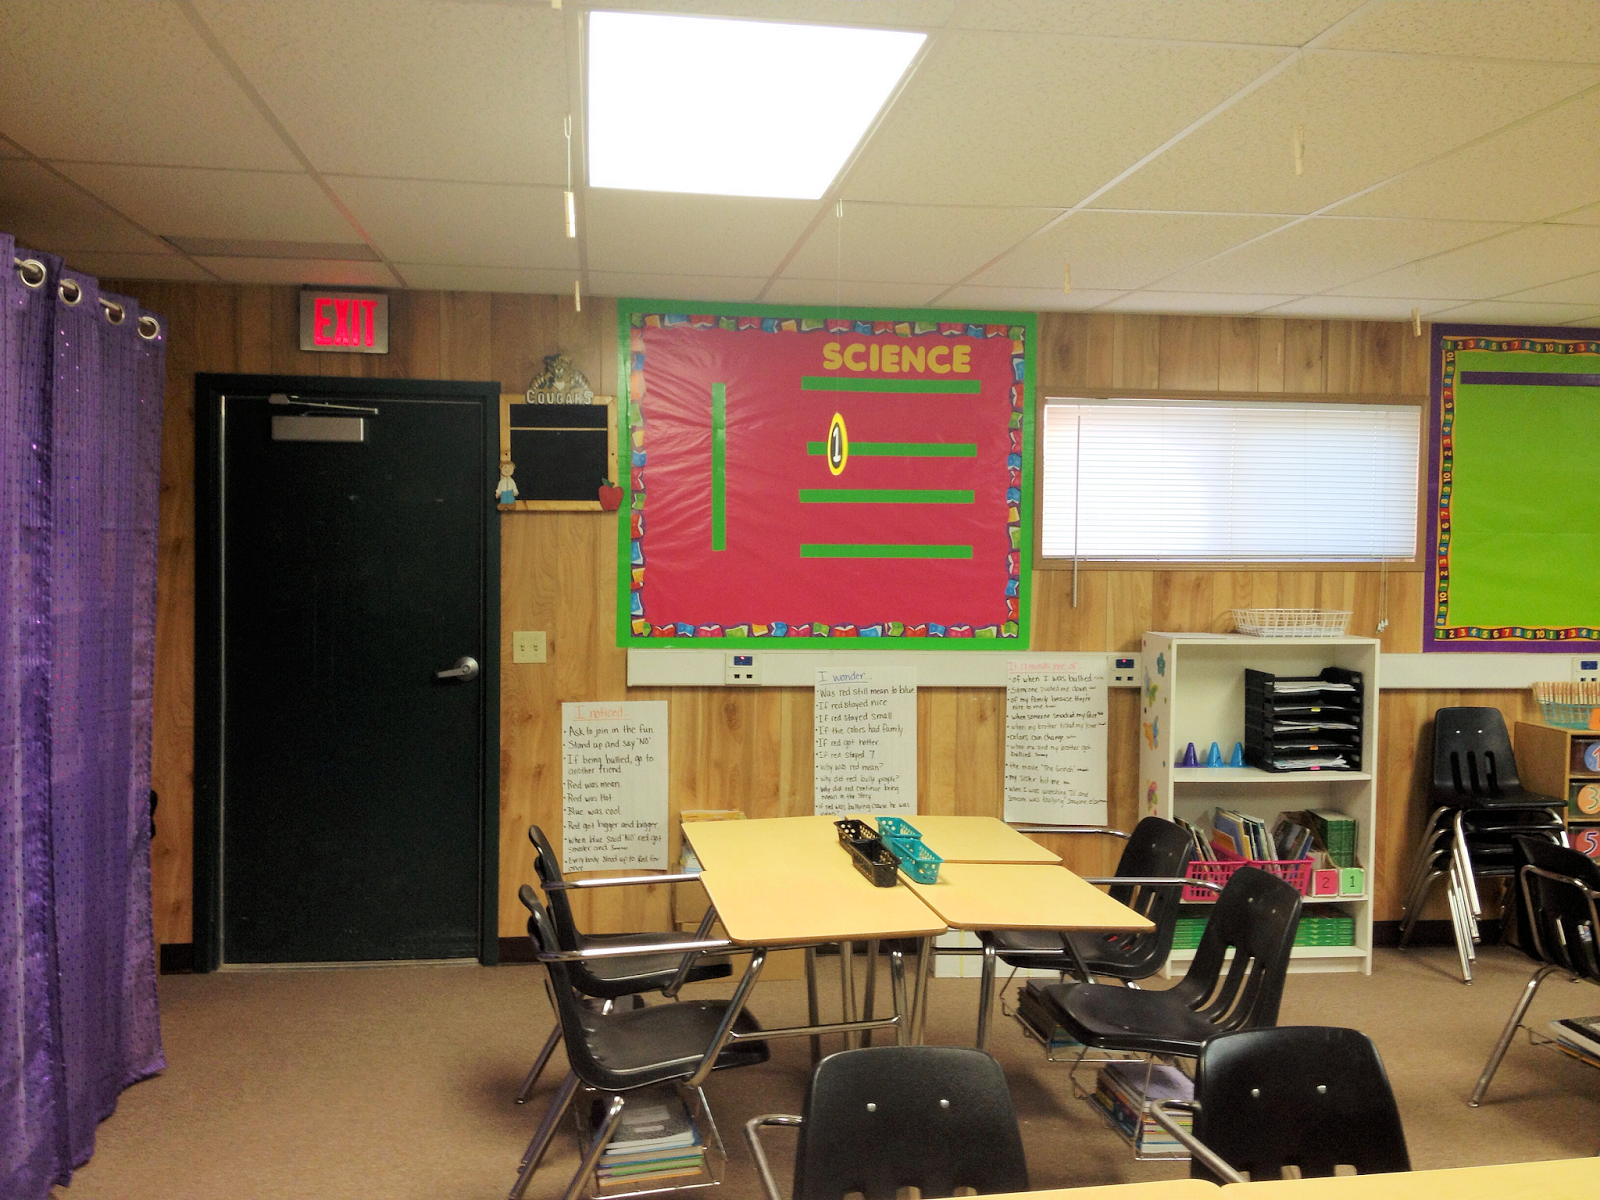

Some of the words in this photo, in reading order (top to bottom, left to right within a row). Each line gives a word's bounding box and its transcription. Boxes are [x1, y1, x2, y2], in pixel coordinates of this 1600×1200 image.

[314, 297, 378, 347] EXIT
[822, 341, 972, 374] SCIENCE
[527, 390, 593, 404] COUGARS
[832, 426, 842, 463] 1
[1449, 630, 1454, 638] 2
[1493, 630, 1499, 638] 6
[1536, 630, 1545, 638] 10
[1571, 629, 1576, 637] 3
[818, 671, 827, 681] I
[1068, 673, 1091, 682] bullied
[820, 688, 835, 697] Was
[839, 687, 850, 696] red
[899, 685, 915, 693] blue
[819, 702, 828, 710] If
[575, 706, 585, 719] I
[871, 712, 892, 720] small
[569, 726, 585, 736] Ask
[594, 728, 608, 737] join
[623, 725, 636, 733] the
[639, 724, 654, 733] fun
[818, 726, 828, 734] If
[847, 726, 865, 734] colors
[868, 724, 880, 732] had
[883, 723, 903, 737] family
[569, 740, 590, 749] Stand
[593, 742, 602, 750] up
[818, 738, 828, 747] If
[844, 740, 855, 749] got
[567, 754, 579, 764] If
[583, 755, 601, 766] being
[635, 756, 643, 766] go
[646, 754, 654, 762] to
[568, 767, 594, 775] another
[599, 764, 621, 773] friend
[567, 780, 582, 789] Red
[861, 775, 875, 784] bully
[567, 793, 582, 802] Red
[1588, 787, 1599, 810] 3
[567, 807, 583, 815] Blue
[606, 806, 621, 815] cool
[568, 821, 580, 829] Red
[583, 823, 594, 831] got
[597, 820, 618, 832] bigger
[621, 820, 634, 828] and
[637, 820, 658, 832] bigger
[650, 835, 661, 845] got
[1584, 831, 1598, 855] 5
[1322, 877, 1329, 888] 2
[1350, 876, 1355, 887] 1
